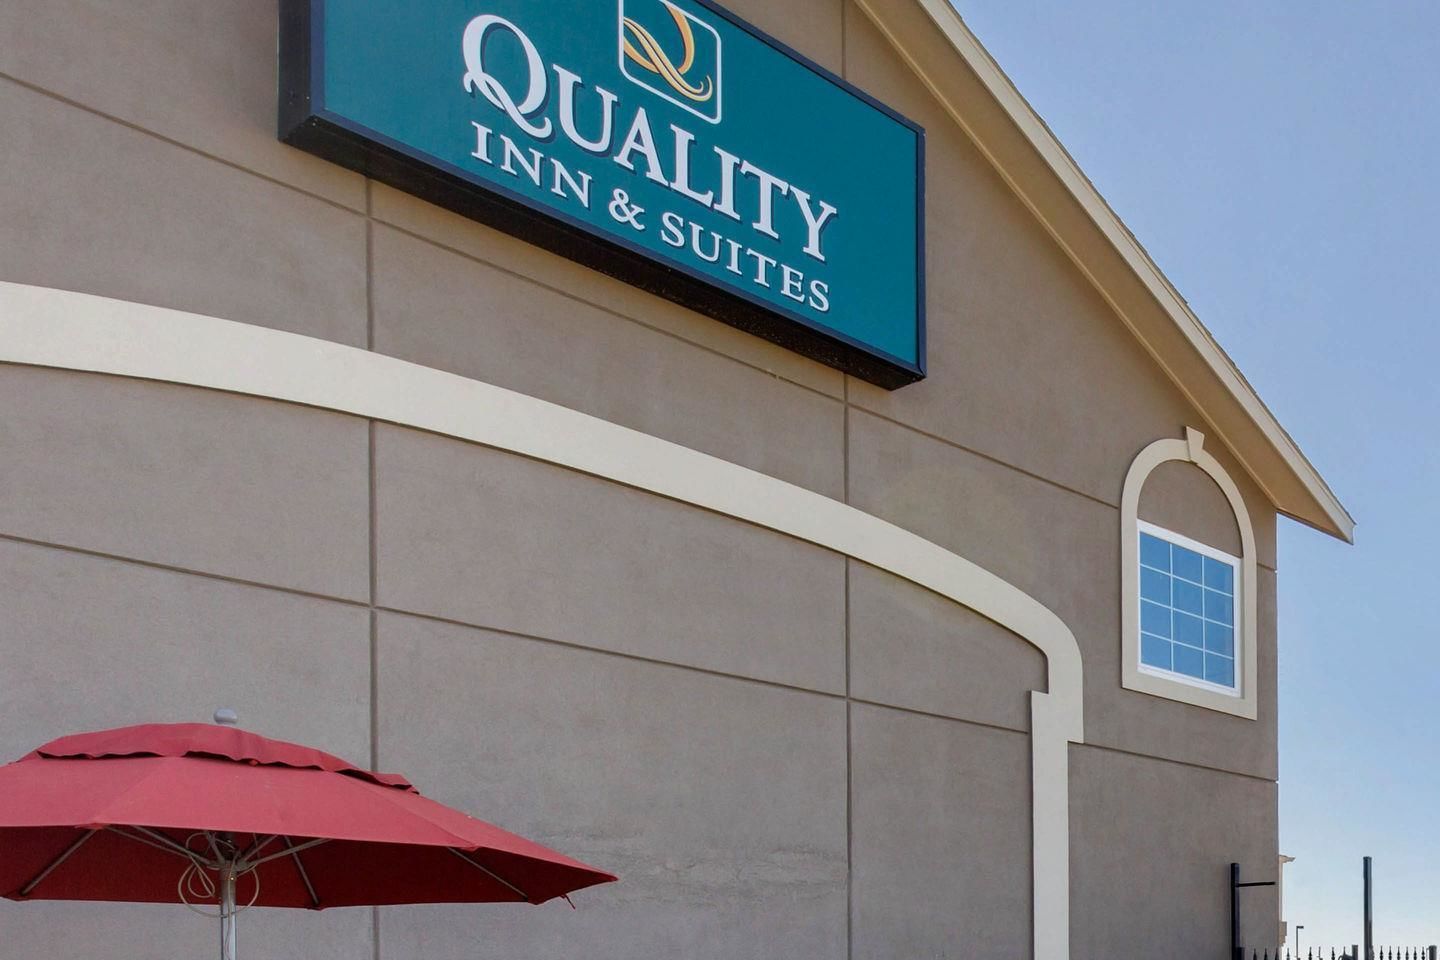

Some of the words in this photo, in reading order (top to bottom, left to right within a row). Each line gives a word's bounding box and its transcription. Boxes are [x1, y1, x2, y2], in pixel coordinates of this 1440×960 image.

[462, 14, 838, 262] QUALITY
[471, 121, 593, 208] INN
[608, 188, 646, 231] &
[660, 211, 831, 312] SUITES
